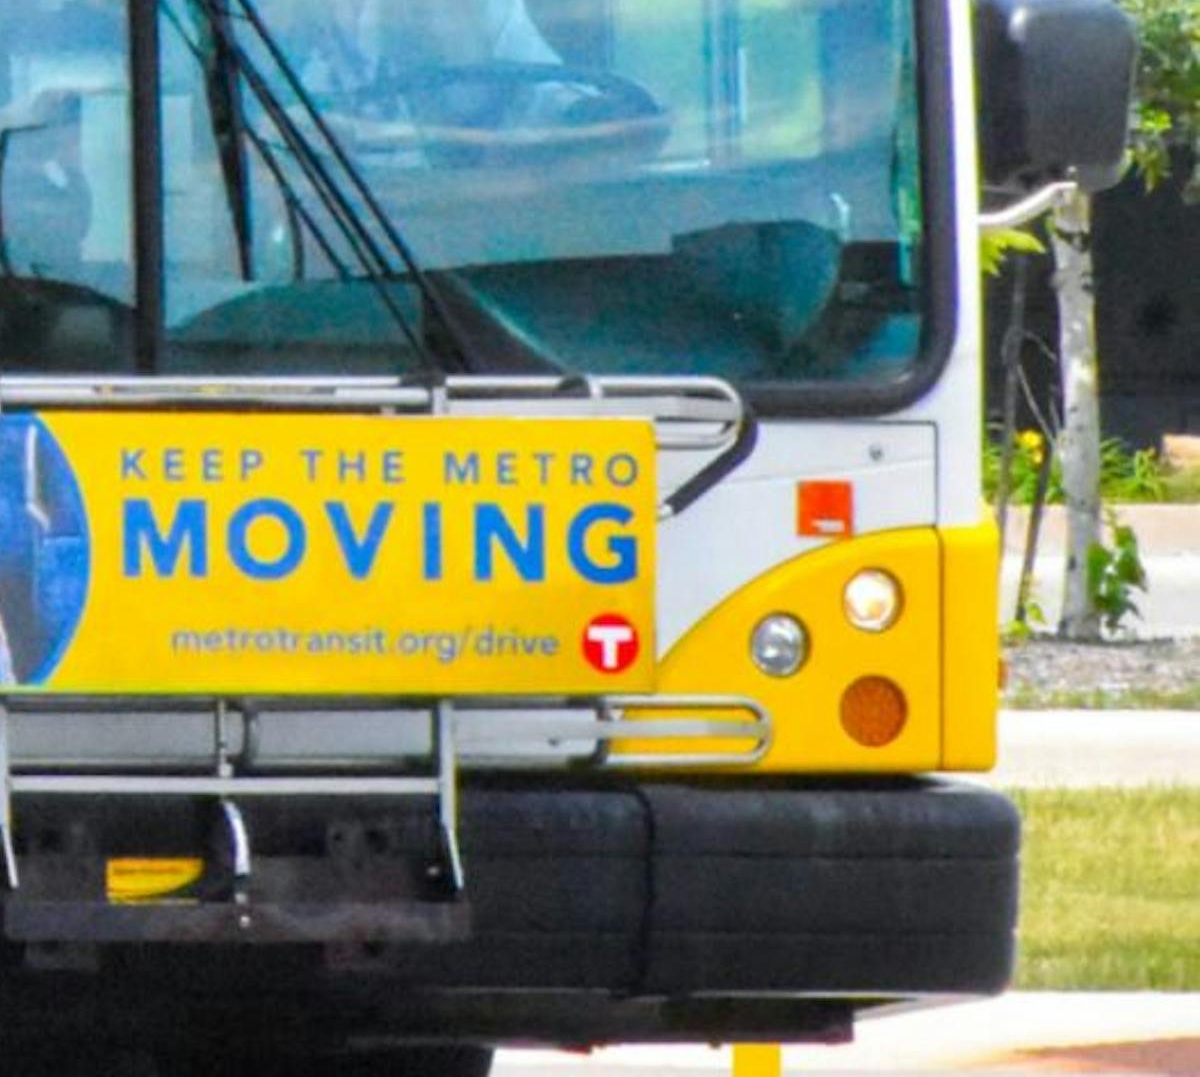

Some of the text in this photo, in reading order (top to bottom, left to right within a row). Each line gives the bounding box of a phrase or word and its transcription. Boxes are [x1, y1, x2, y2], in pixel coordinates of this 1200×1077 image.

[121, 449, 640, 486] KEEP THE METRO
[122, 497, 639, 584] MOVING
[172, 626, 560, 662] metrotransit.org/drive
